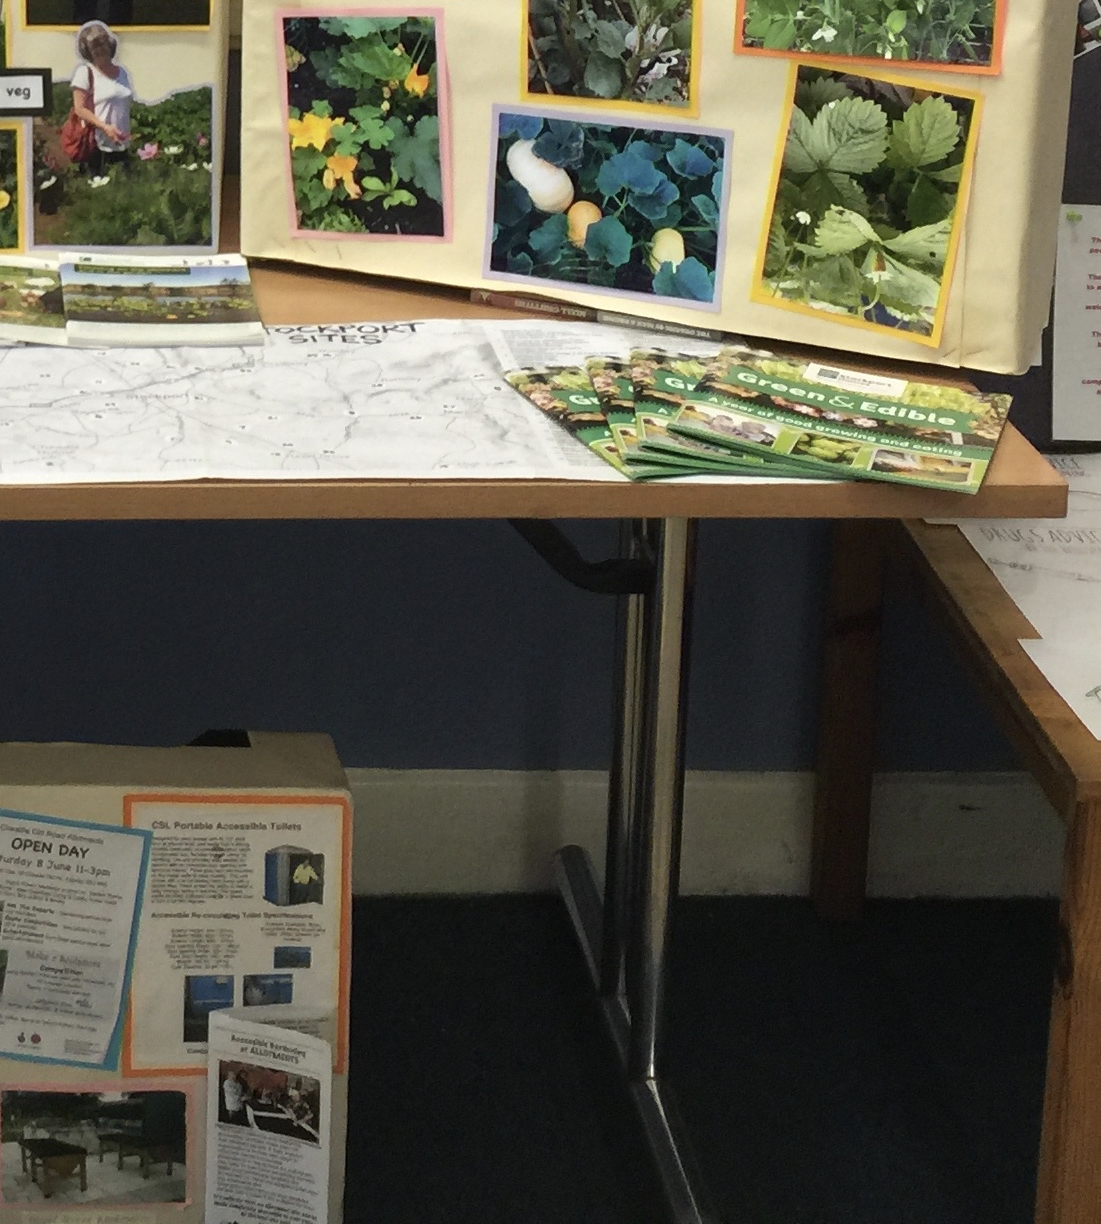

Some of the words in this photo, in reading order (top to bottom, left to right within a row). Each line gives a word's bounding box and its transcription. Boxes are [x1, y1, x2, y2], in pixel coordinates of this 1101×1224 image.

[6, 87, 31, 100] veg
[289, 334, 382, 345] SITES
[737, 372, 825, 402] Green
[829, 395, 854, 410] &
[860, 401, 956, 426] Edible
[708, 396, 718, 404] A
[722, 400, 754, 413] year
[757, 410, 773, 418] of
[775, 415, 812, 430] good
[816, 424, 876, 443] growing
[880, 437, 909, 448] and
[913, 443, 962, 458] eating
[152, 821, 170, 829] CSL
[174, 821, 214, 830] Portable
[216, 822, 267, 830] Accessible
[271, 823, 302, 831] Toilets
[11, 837, 53, 854] OPEN
[59, 844, 90, 859] DAY
[36, 859, 43, 868] 8
[47, 860, 71, 871] June
[76, 864, 110, 877] 11-3pm
